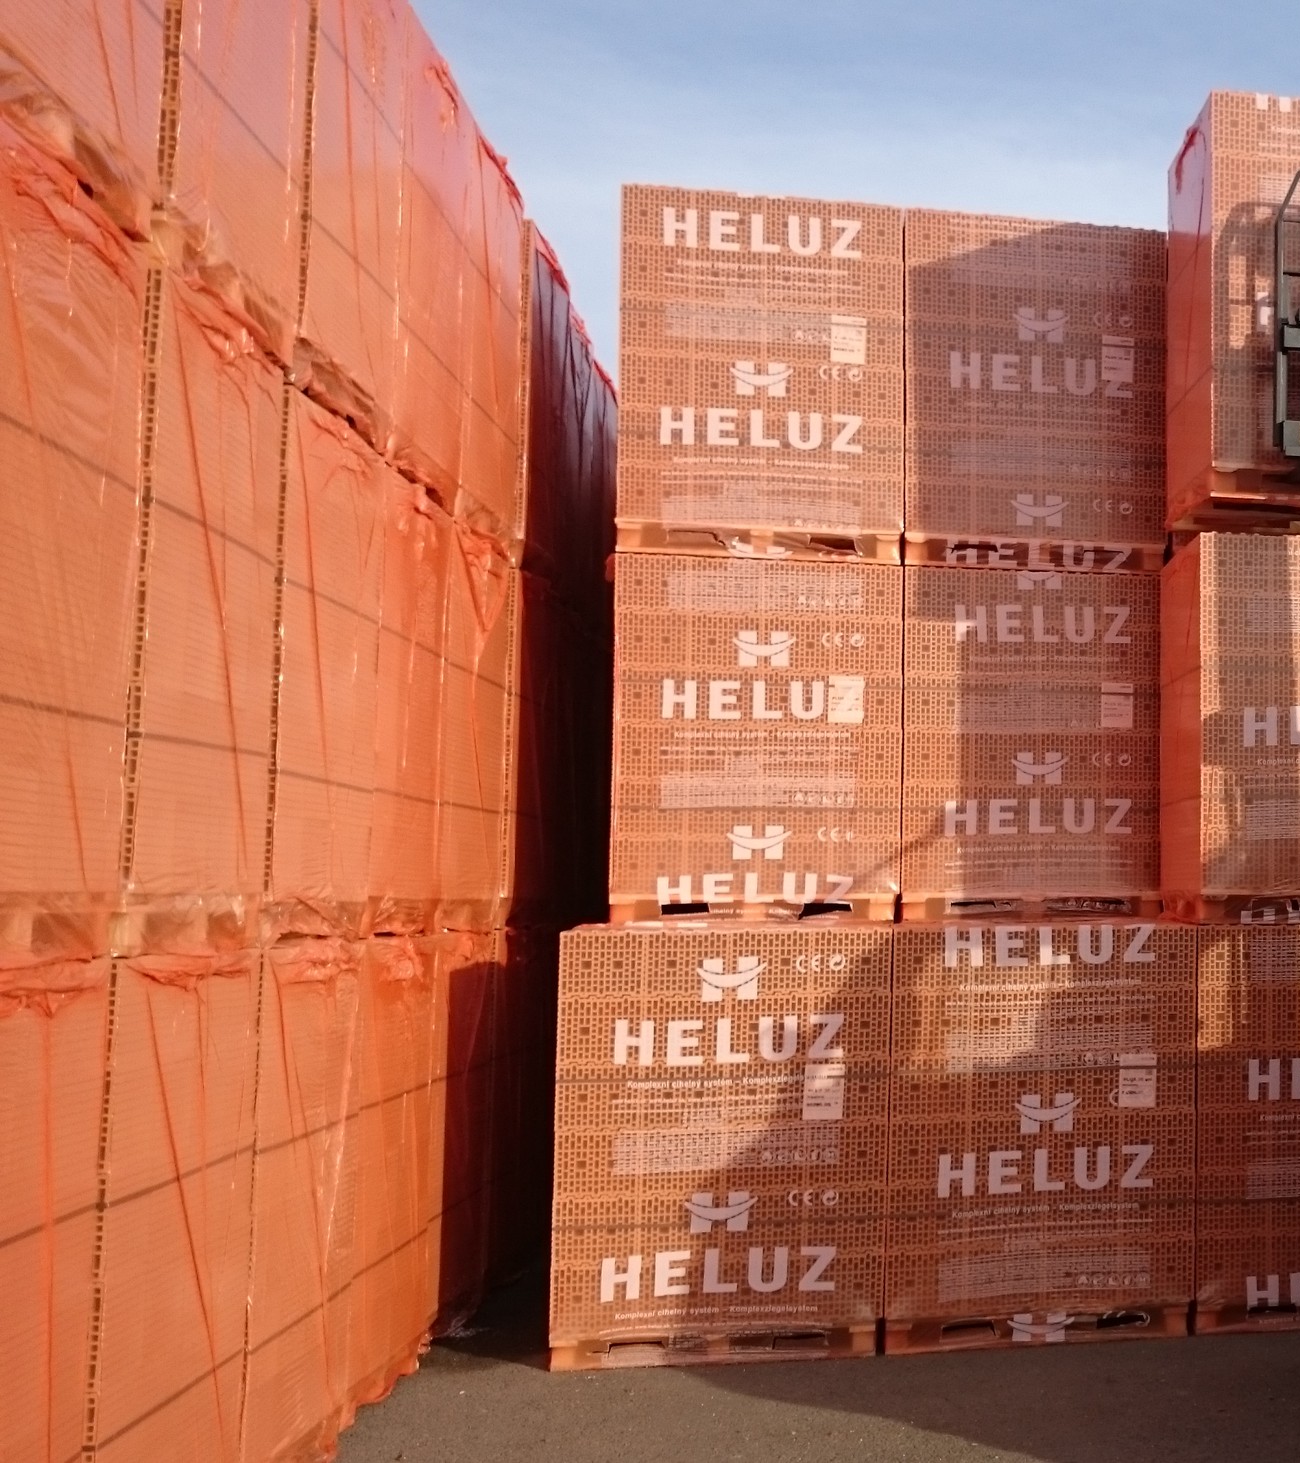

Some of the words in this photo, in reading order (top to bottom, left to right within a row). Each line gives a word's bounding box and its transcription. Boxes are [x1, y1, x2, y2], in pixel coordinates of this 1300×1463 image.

[662, 206, 862, 258] HELUZ
[659, 406, 863, 454] HELUZ
[955, 605, 1131, 643] HELUZ
[944, 798, 1132, 836] HELUZ
[657, 872, 853, 906] HELUZ
[944, 924, 1156, 967] HELUZ
[612, 1013, 845, 1066] HELUZ
[937, 1145, 1153, 1198] HELUZ
[600, 1247, 837, 1302] HELUZ
